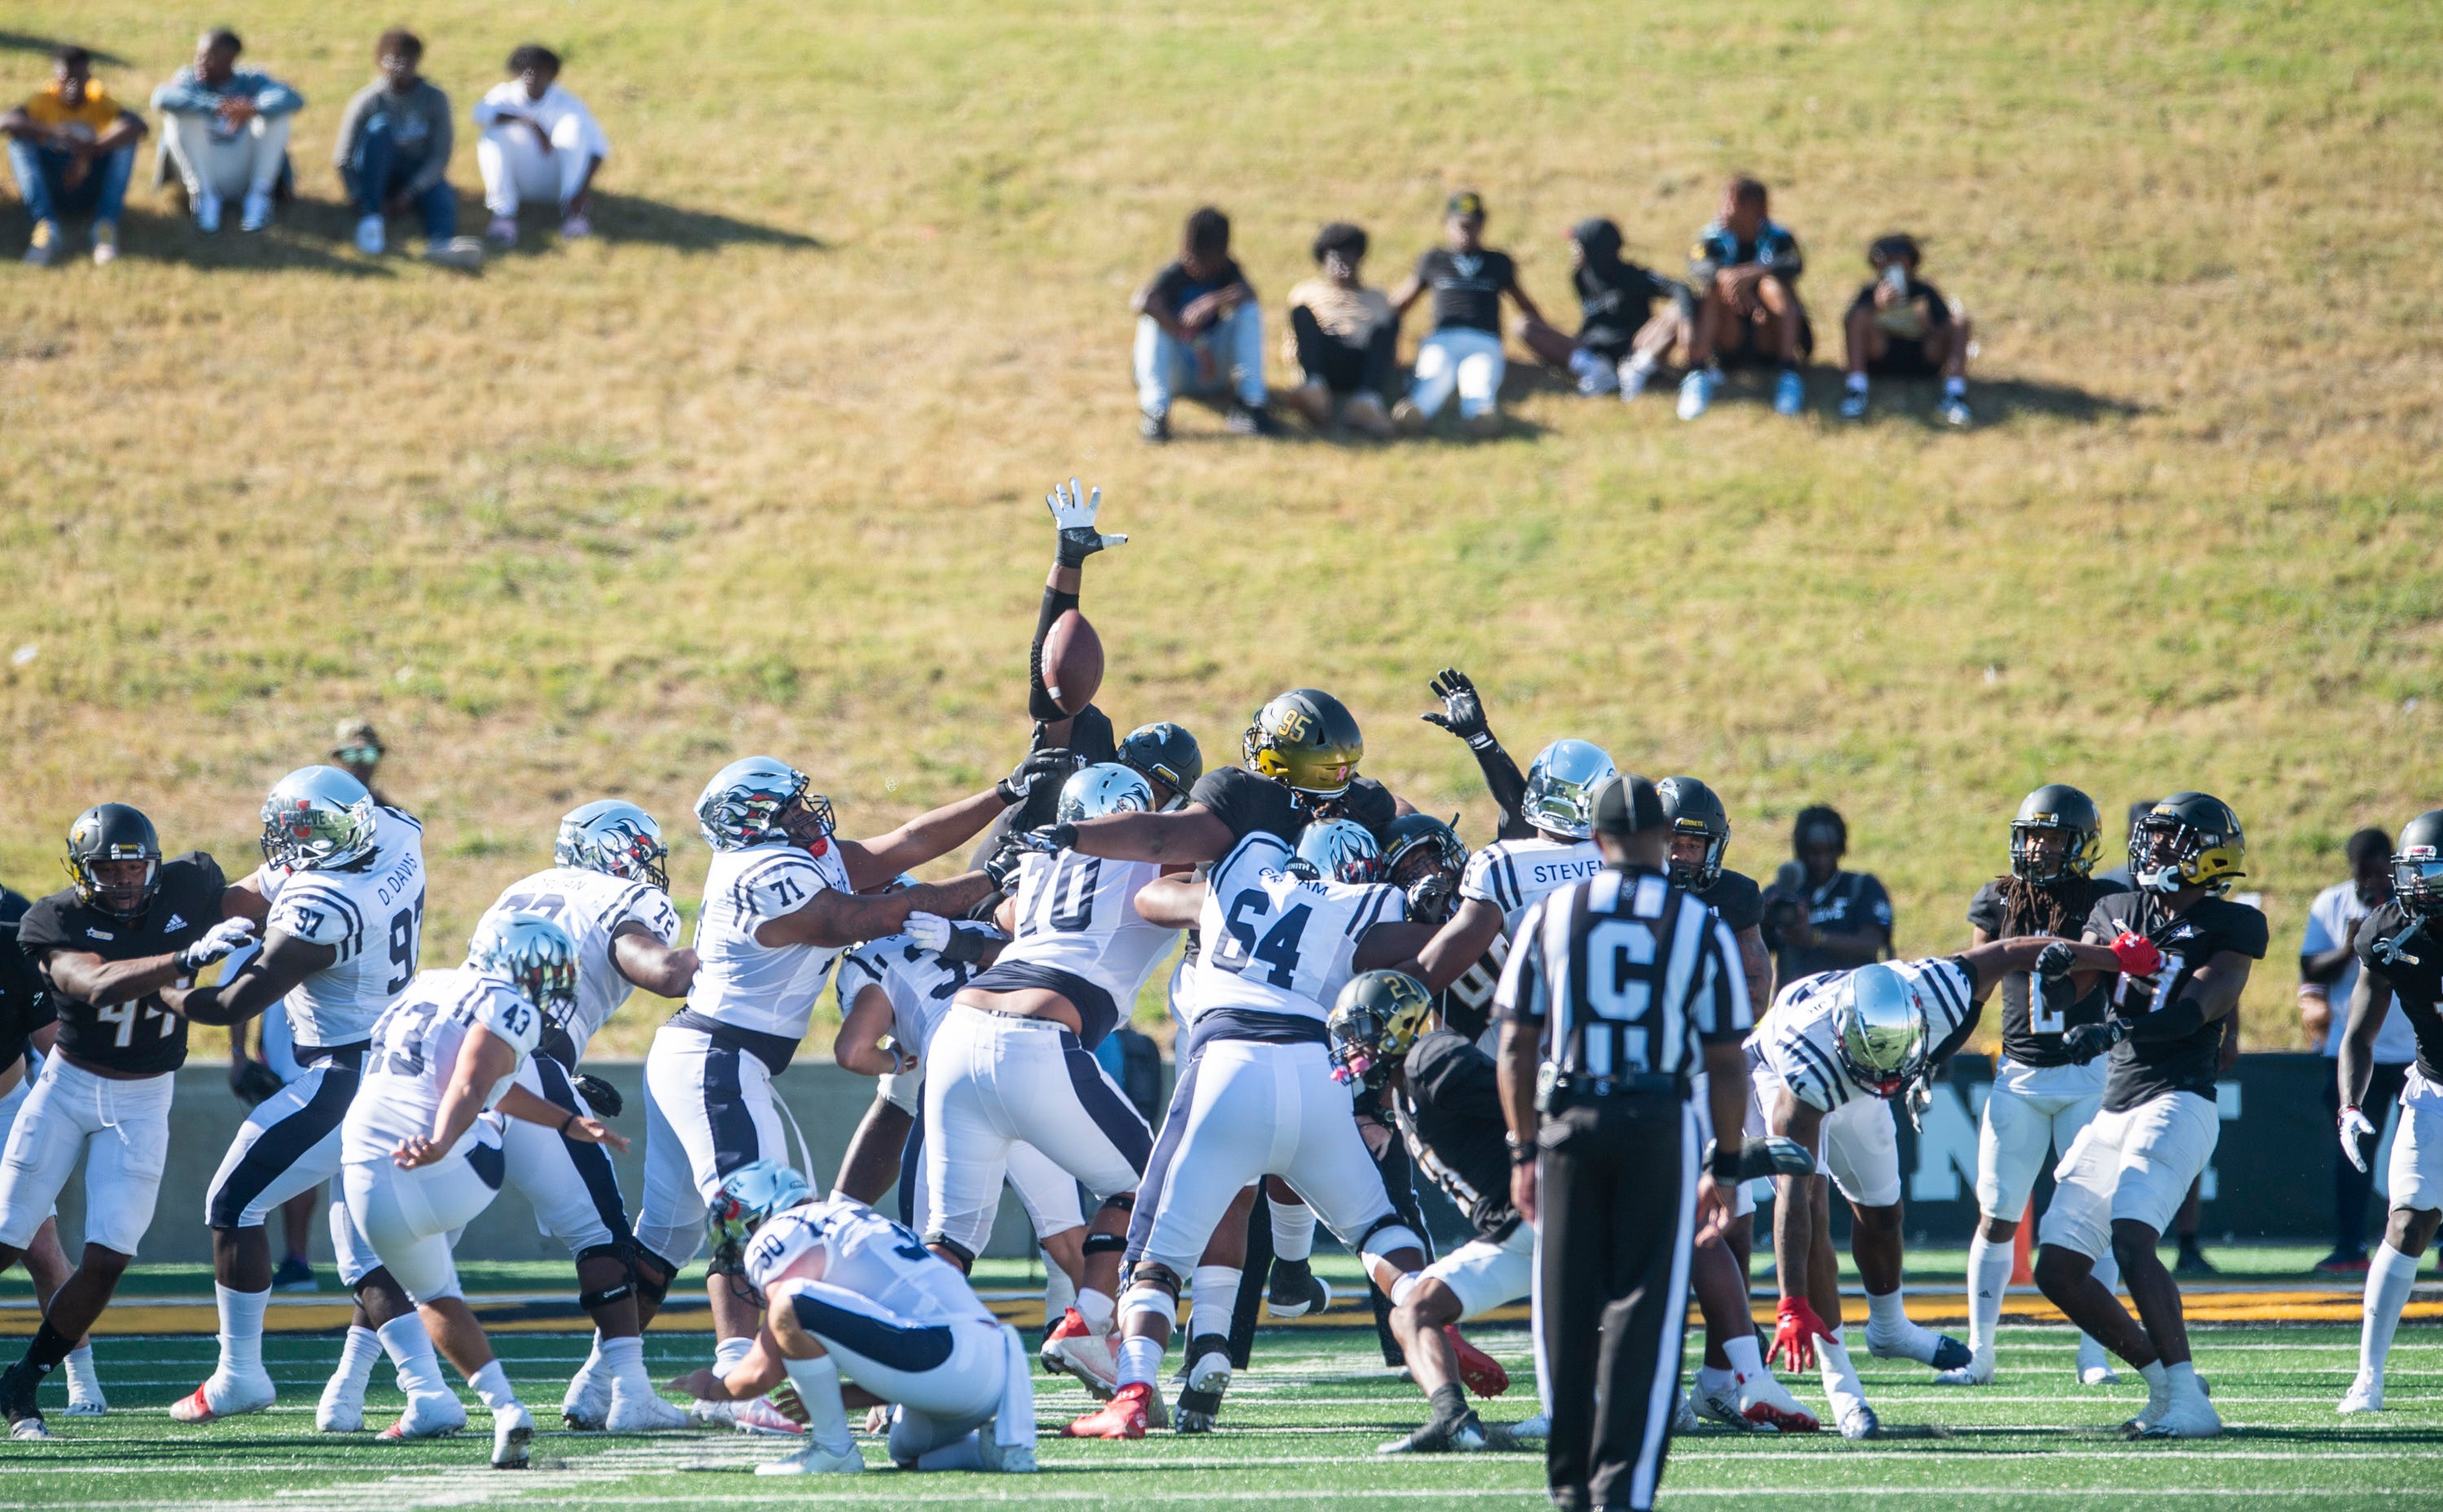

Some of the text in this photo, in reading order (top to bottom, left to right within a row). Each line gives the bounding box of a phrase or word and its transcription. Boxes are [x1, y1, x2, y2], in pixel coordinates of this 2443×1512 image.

[1277, 708, 1314, 743] 95
[378, 852, 419, 907] D. DAVIS
[769, 876, 805, 908] 71
[1019, 852, 1102, 939] 70
[1259, 867, 1329, 896] GRAM
[294, 907, 326, 939] 97
[652, 901, 675, 938] 72
[1210, 887, 1314, 991] 64
[1586, 918, 1658, 1023] C
[502, 1002, 531, 1037] 43
